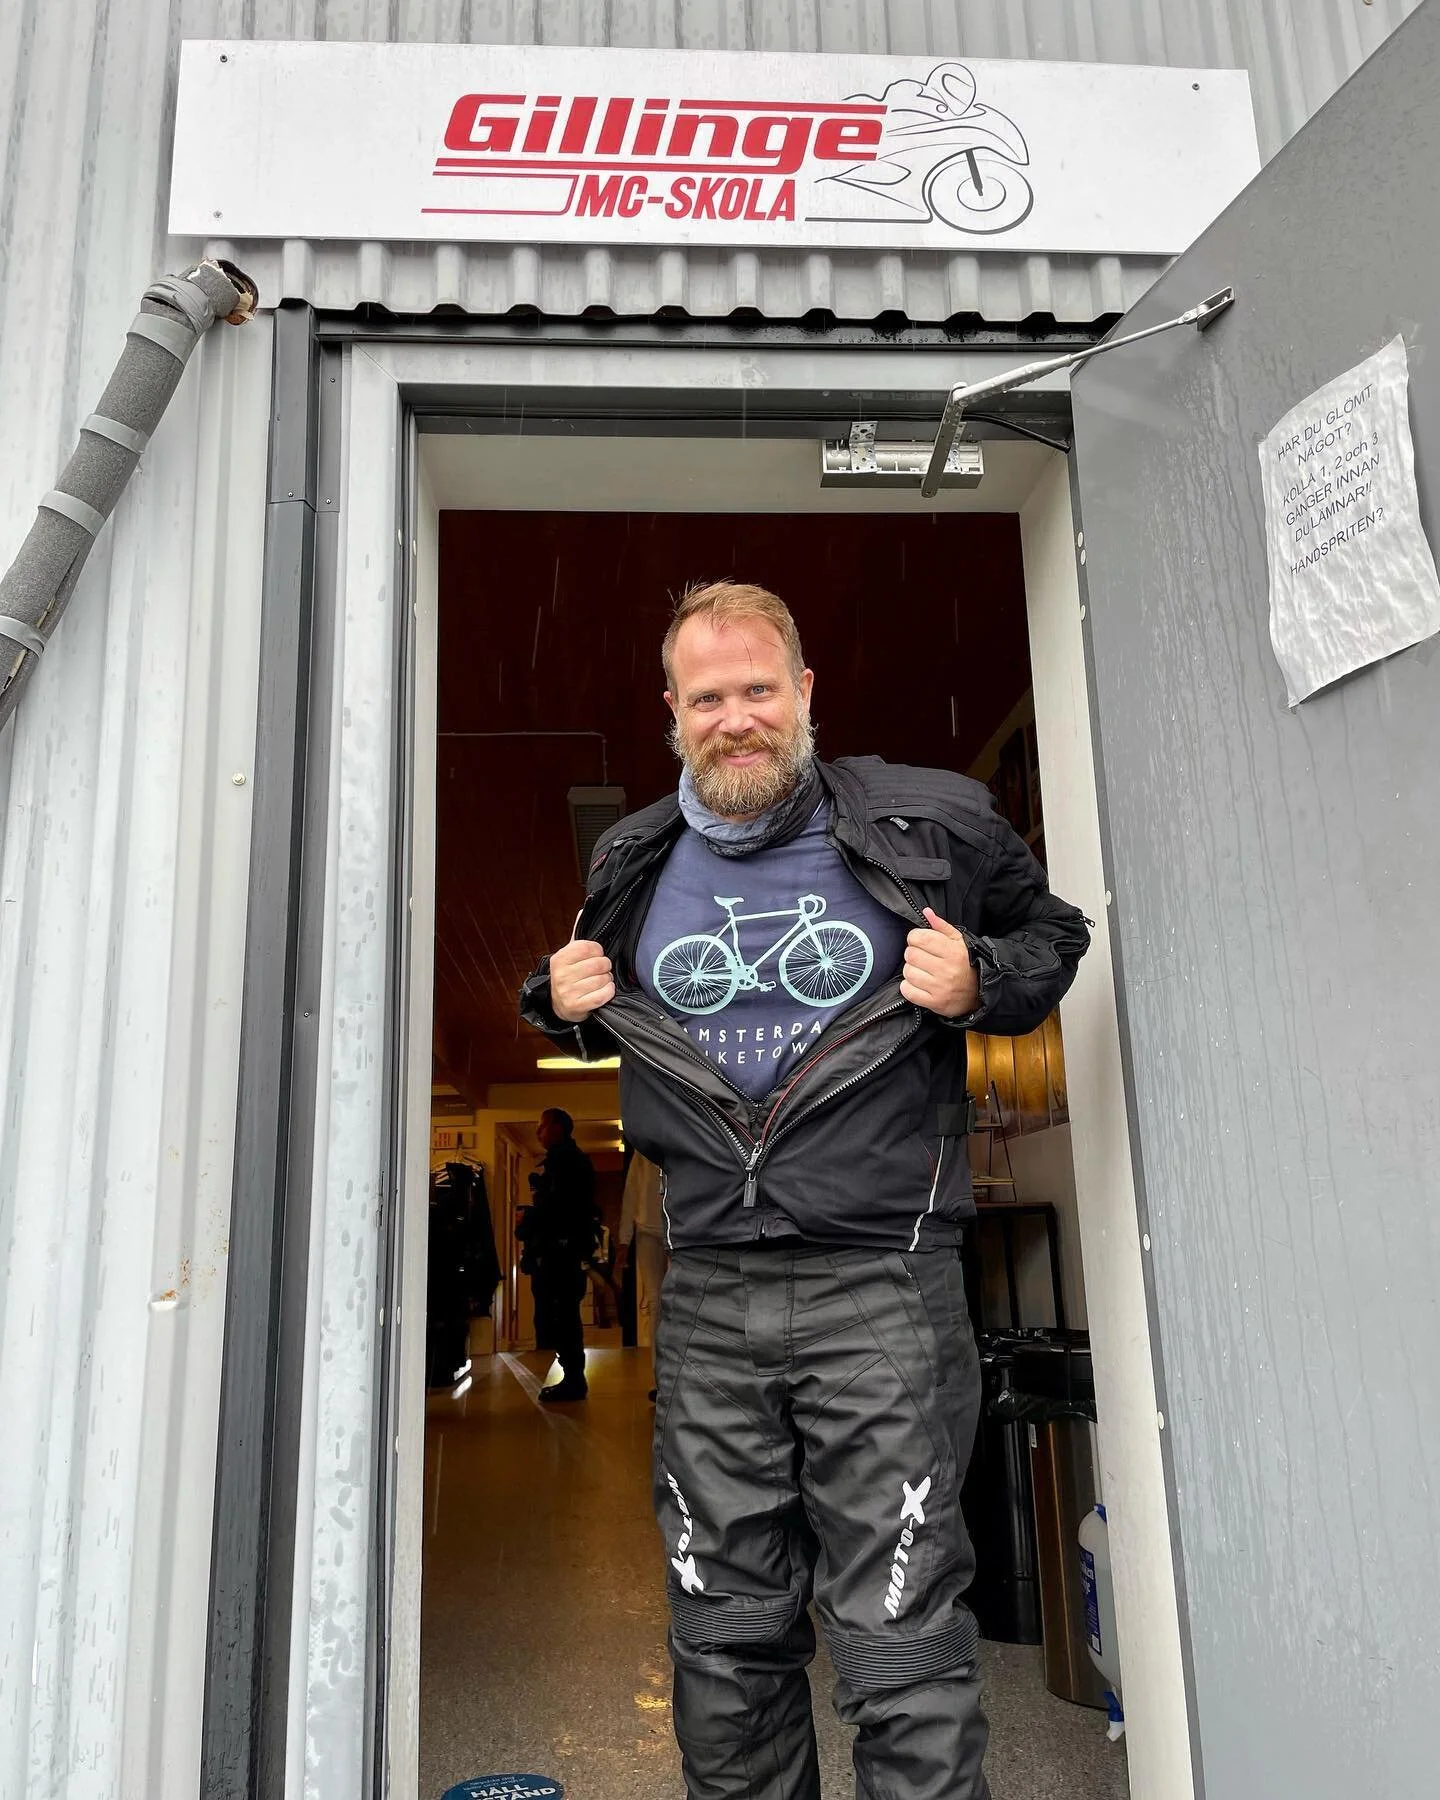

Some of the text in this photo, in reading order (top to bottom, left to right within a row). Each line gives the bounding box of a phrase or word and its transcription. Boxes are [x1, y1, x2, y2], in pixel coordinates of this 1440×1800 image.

[444, 94, 886, 173] Gillinge
[575, 174, 796, 221] MC-SKOLA
[1277, 383, 1373, 462] HAR DU GLÖMT
[1282, 472, 1316, 507] KOLLA
[1335, 455, 1343, 470] 2
[1345, 441, 1369, 462] och
[1372, 431, 1379, 446] 3
[1336, 452, 1380, 490] INNAN
[1289, 507, 1384, 576] HANDSPRITEN?
